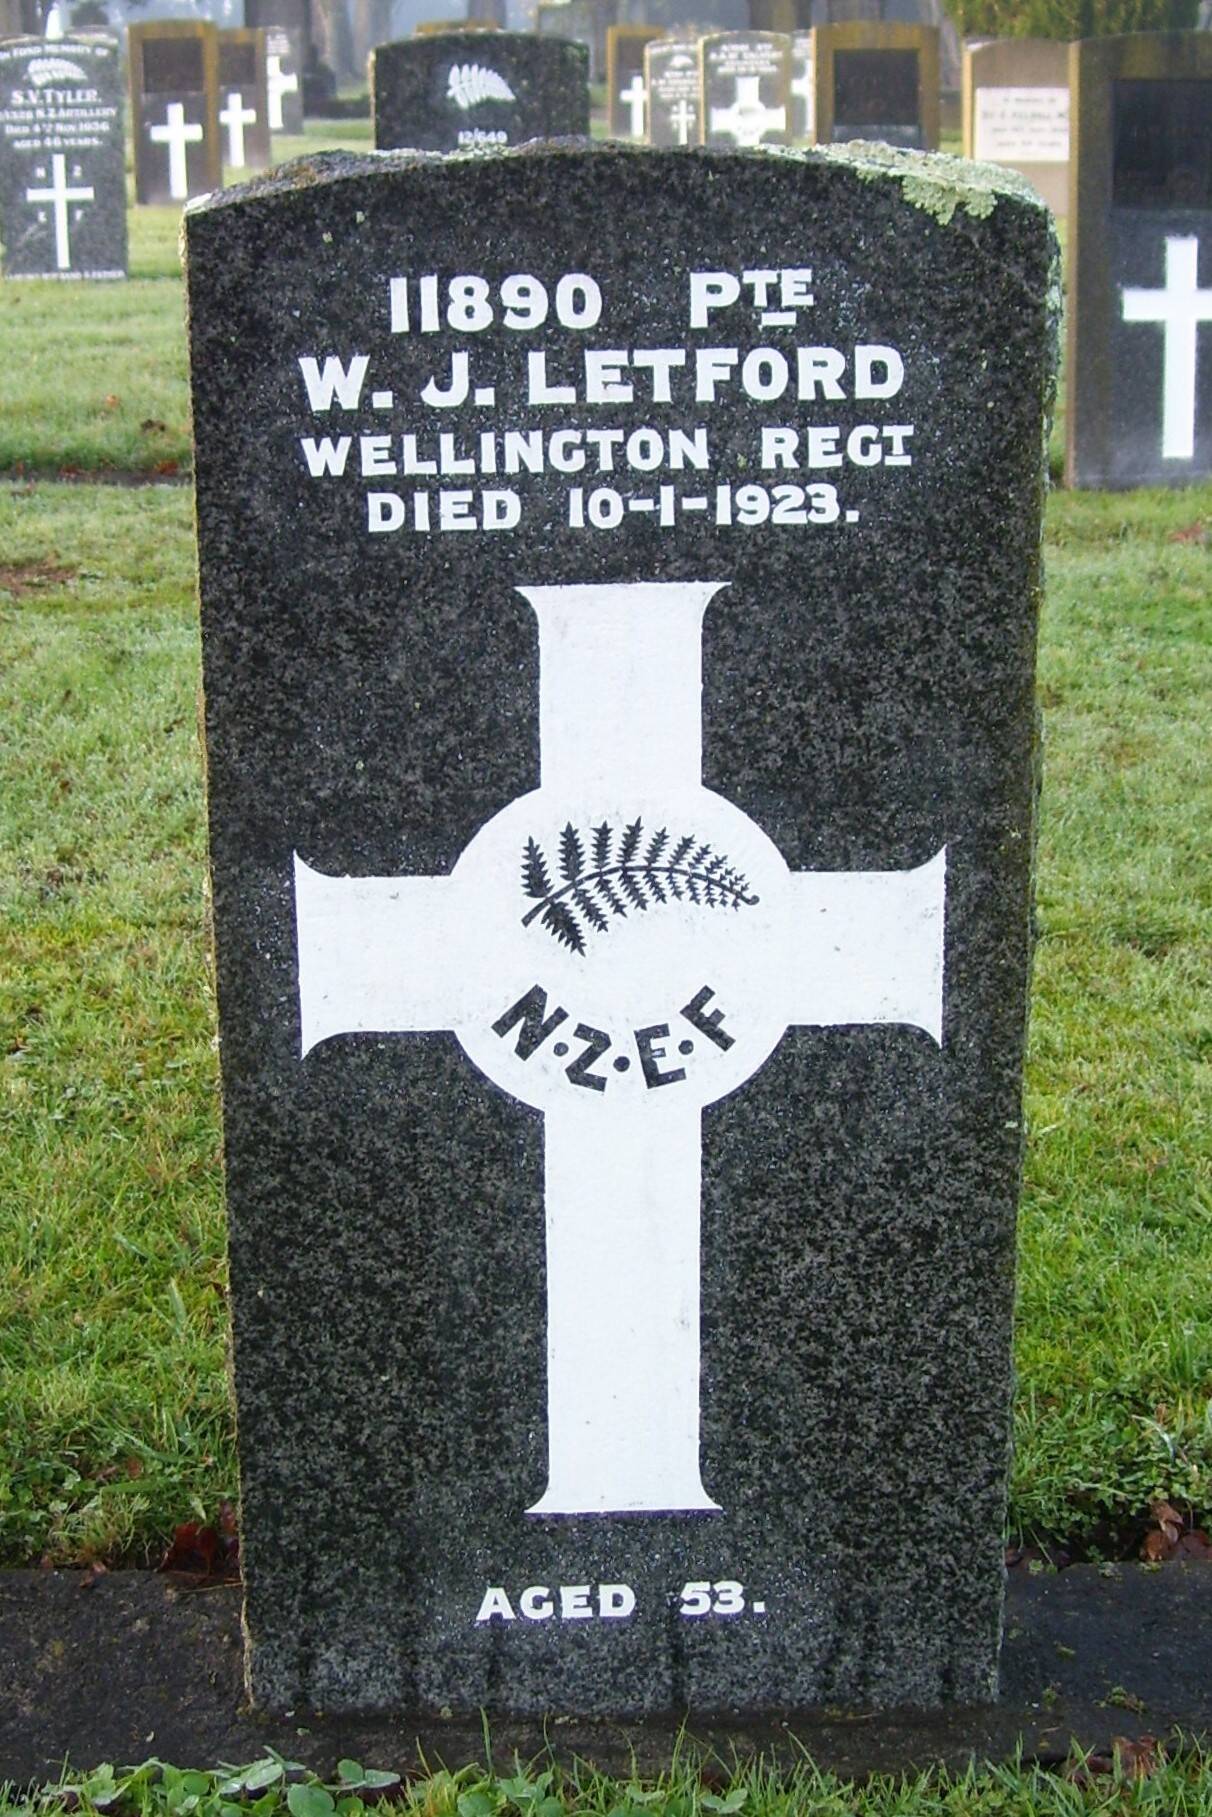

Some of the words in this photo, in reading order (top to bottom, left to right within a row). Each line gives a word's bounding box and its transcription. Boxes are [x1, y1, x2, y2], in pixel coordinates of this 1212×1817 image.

[390, 274, 602, 332] 11890
[299, 354, 393, 411] W.
[421, 351, 494, 407] J.
[528, 345, 904, 405] LETFORD
[301, 427, 710, 476] WELLINGTON
[762, 425, 913, 468] REGT
[368, 488, 521, 532] DIED
[569, 484, 859, 529] 10-1-1923.
[476, 1584, 635, 1620] AGED
[680, 1581, 765, 1614] 53.
